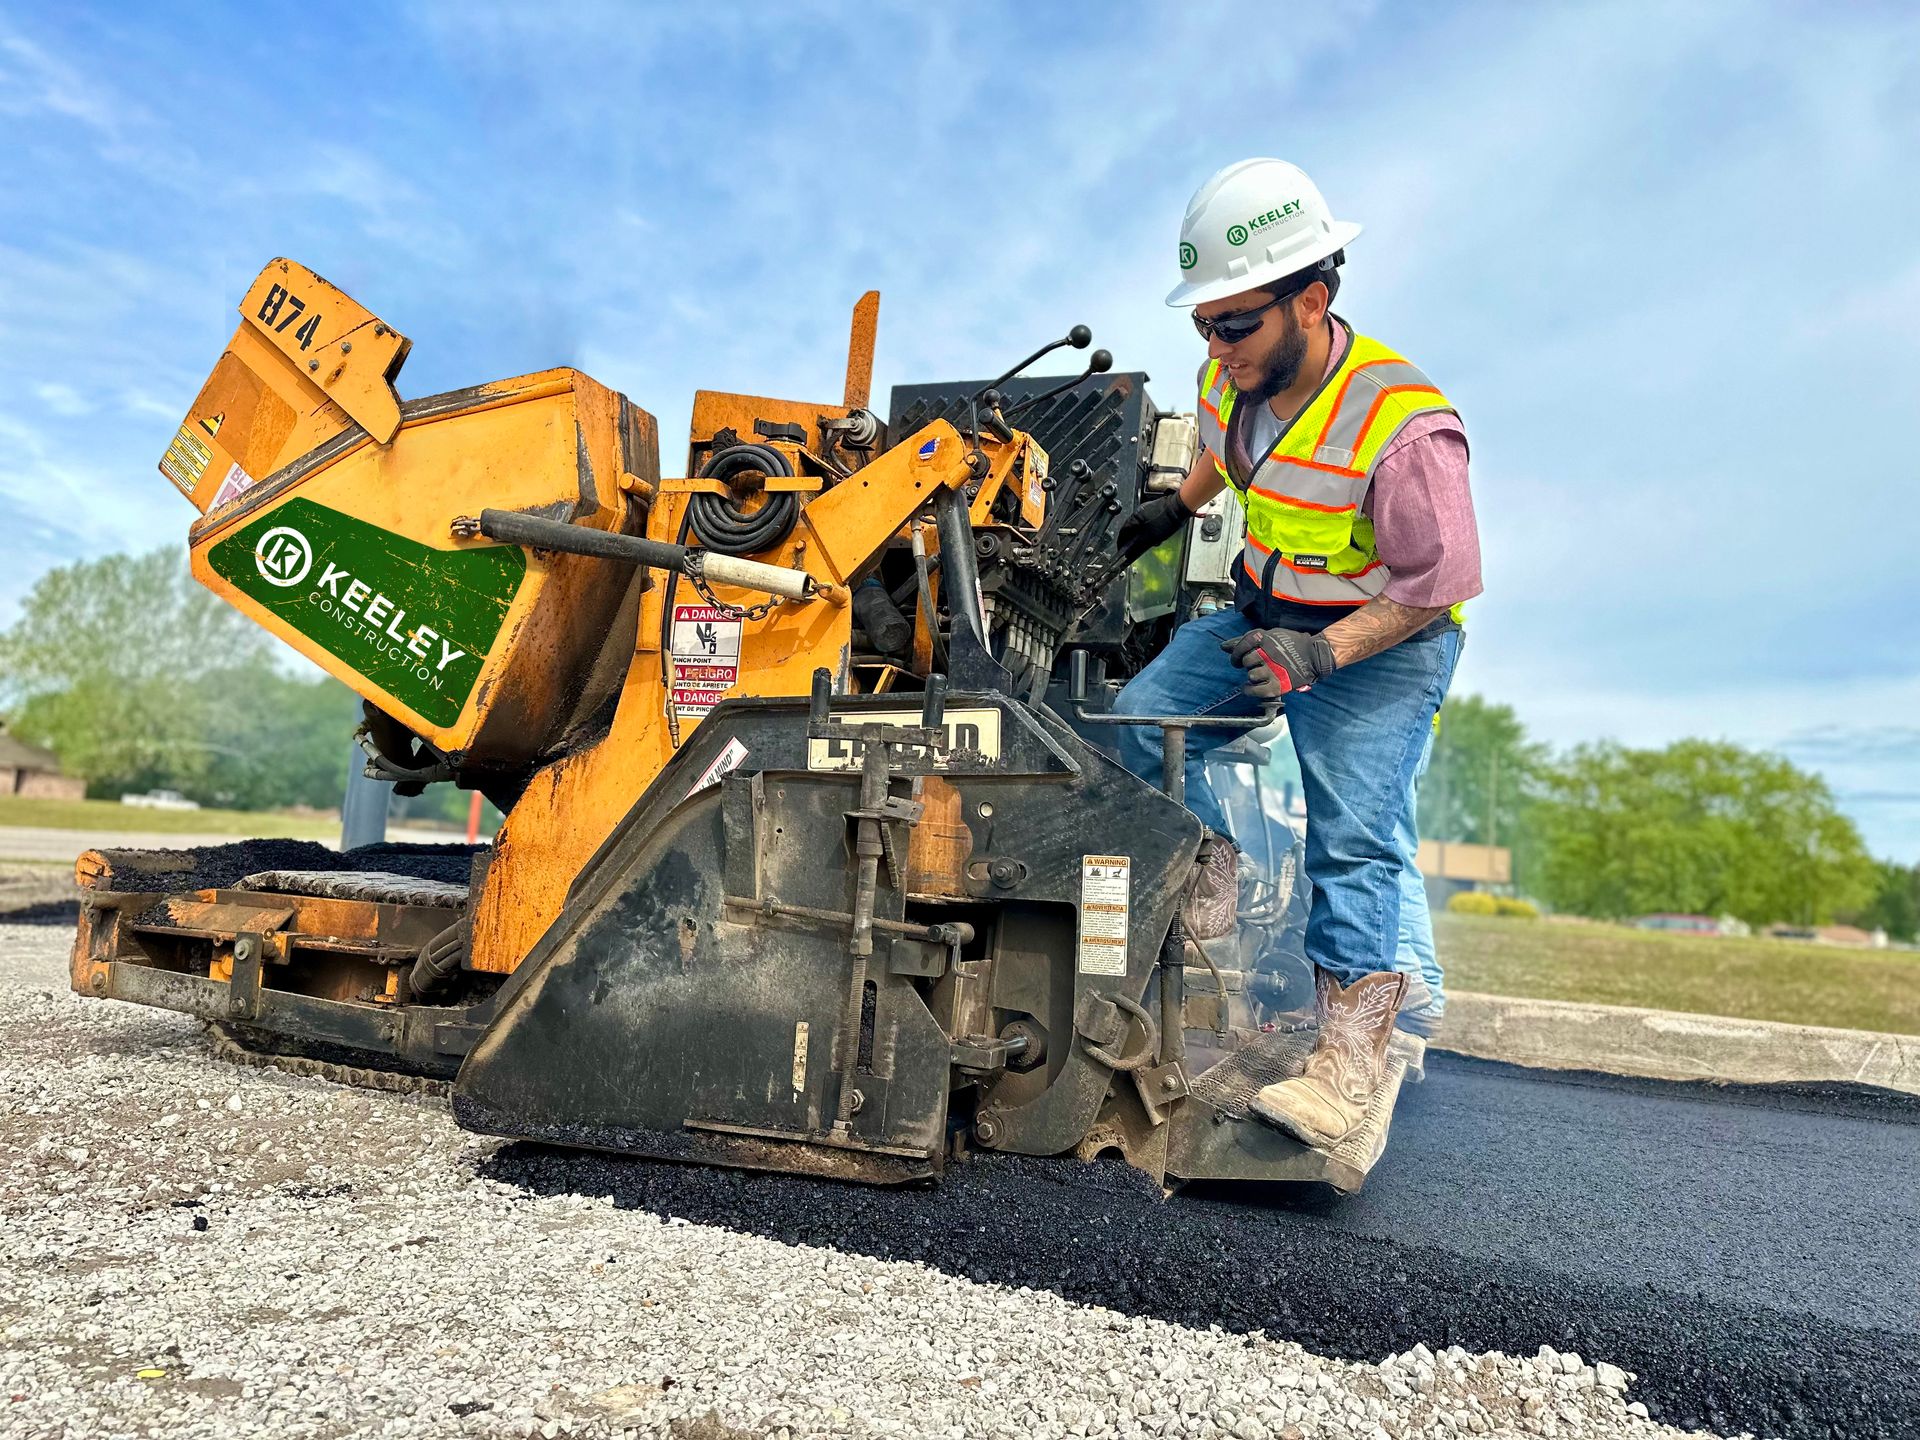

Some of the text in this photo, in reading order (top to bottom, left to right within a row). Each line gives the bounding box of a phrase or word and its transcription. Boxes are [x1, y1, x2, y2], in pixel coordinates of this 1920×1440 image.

[1248, 199, 1301, 231] KEELEY
[1252, 210, 1305, 237] CONSTRUCTION
[257, 283, 322, 352] 874
[317, 562, 466, 671] KEELEY
[692, 609, 736, 620] DANGE
[309, 591, 444, 691] CONSTRUCTION
